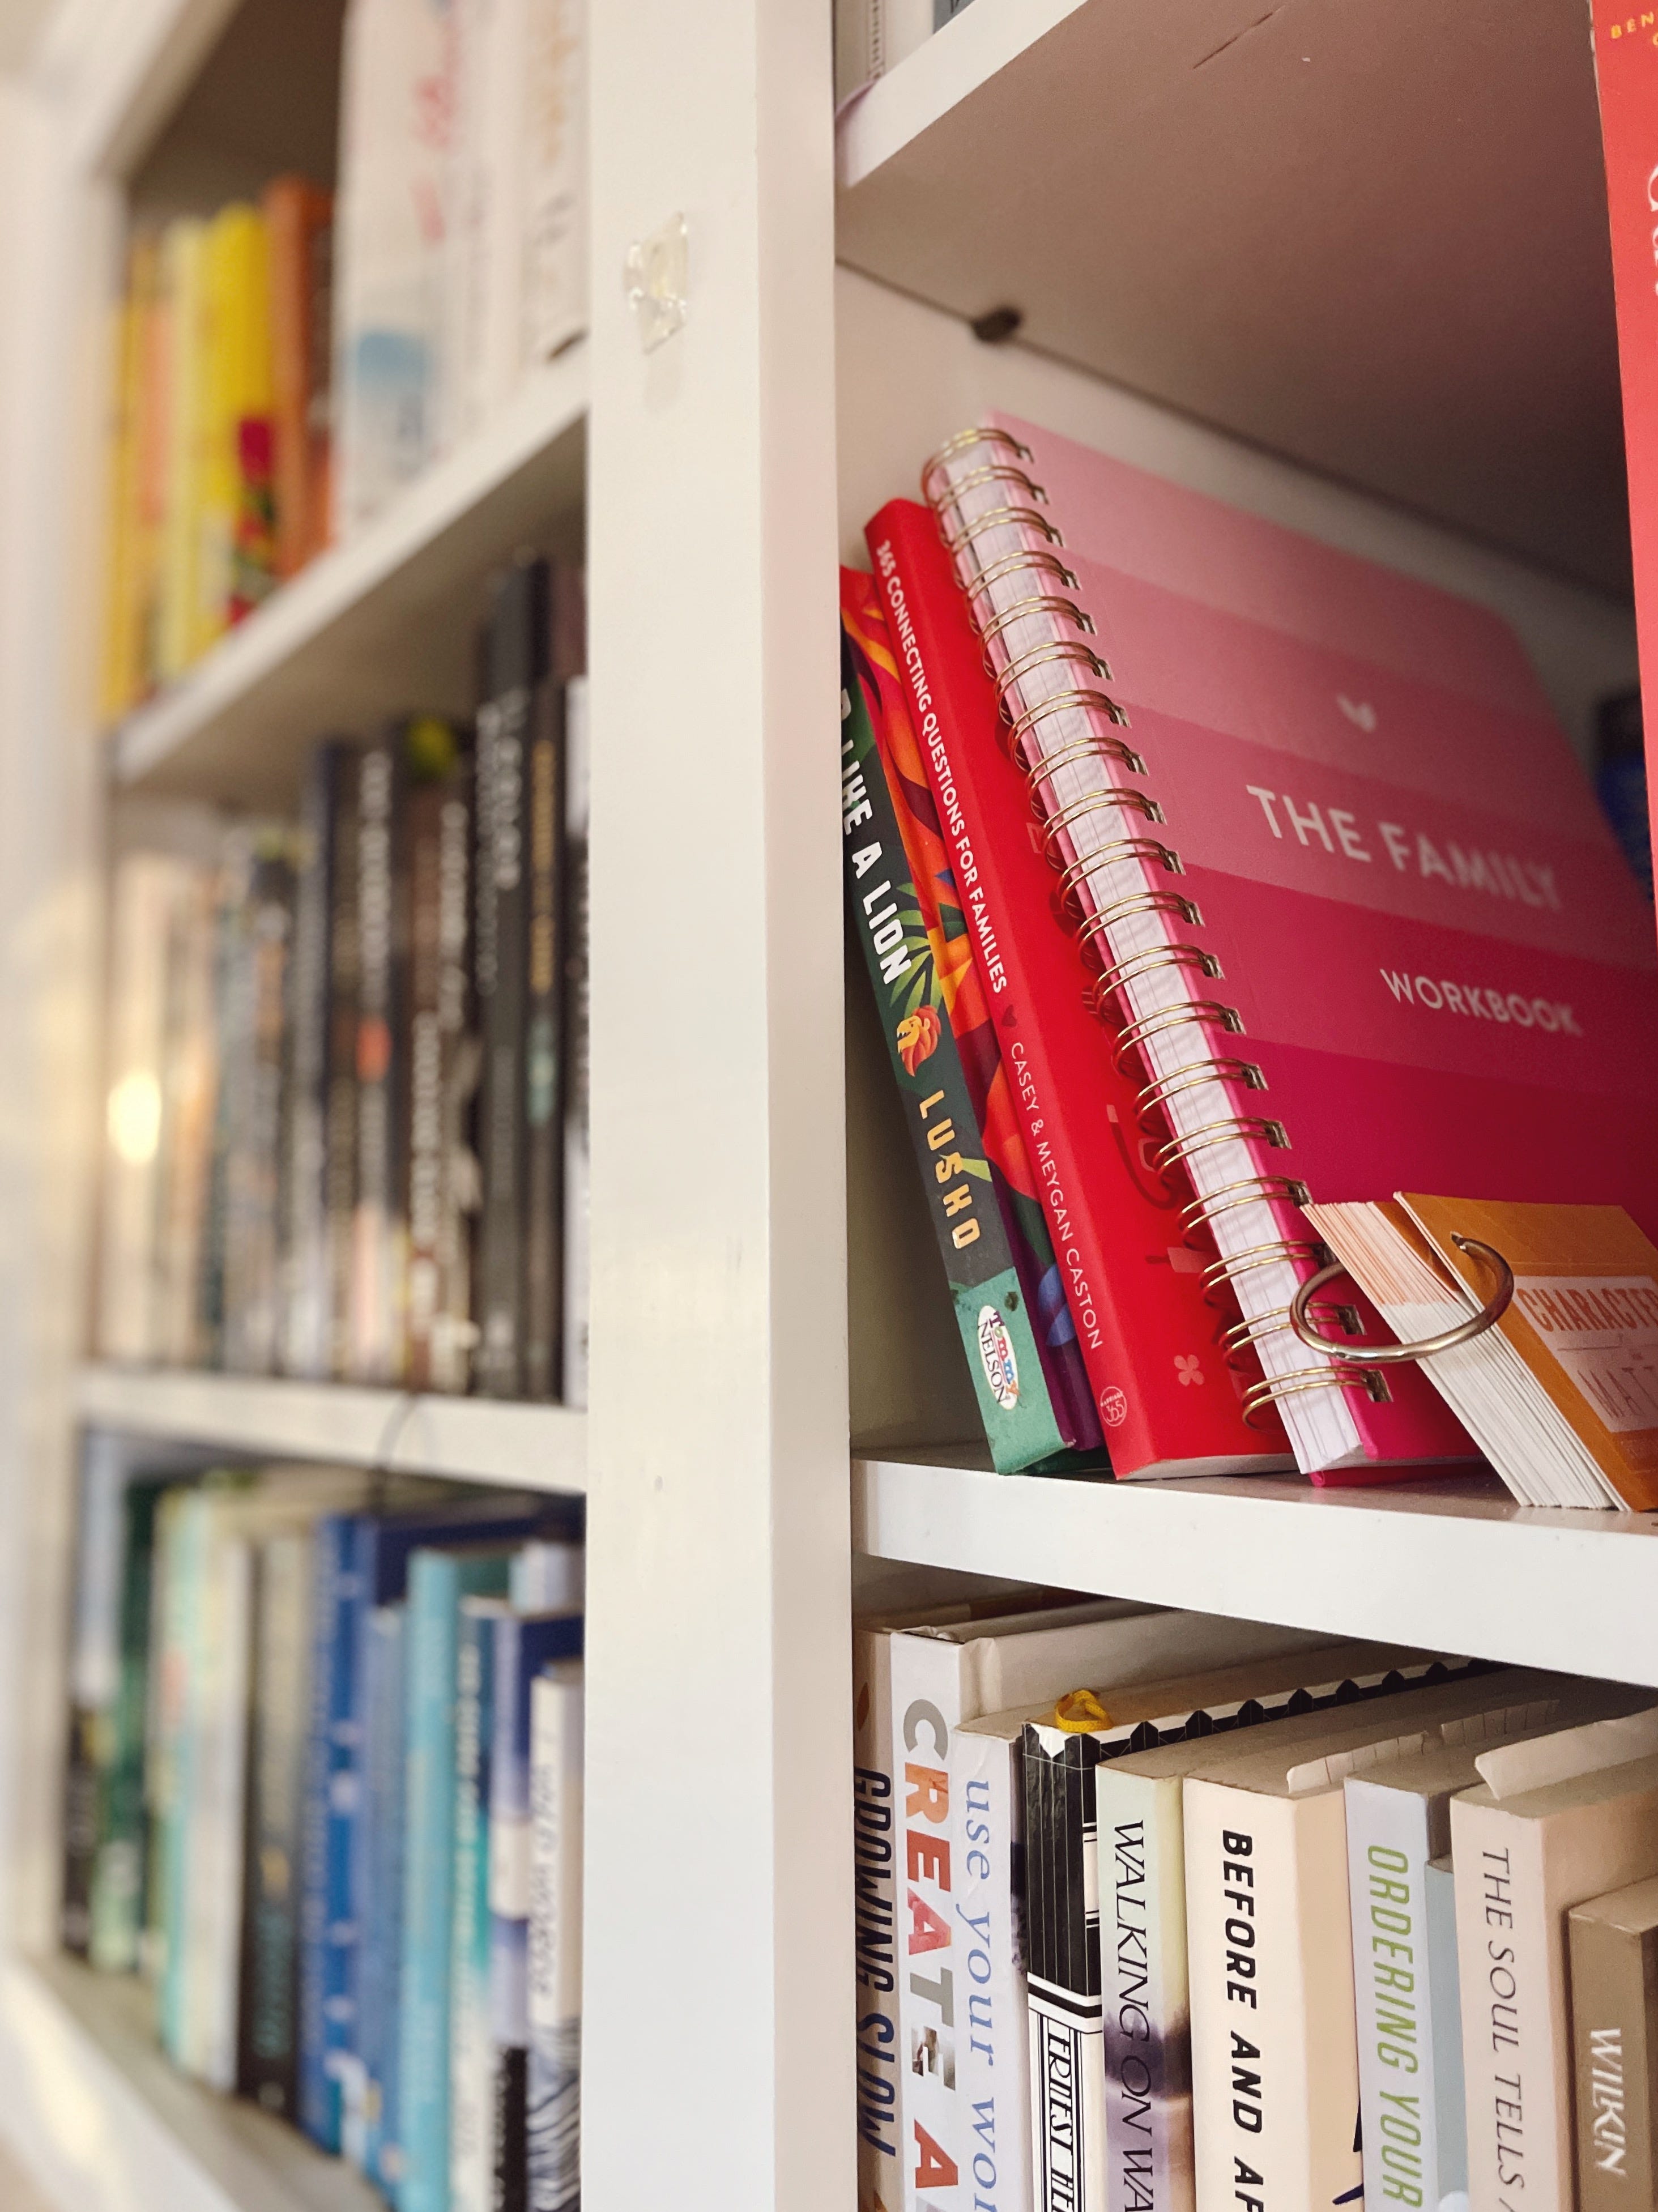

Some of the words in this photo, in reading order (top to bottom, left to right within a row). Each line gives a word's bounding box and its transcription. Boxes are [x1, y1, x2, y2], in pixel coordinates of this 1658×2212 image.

[876, 539, 896, 577] 365
[886, 576, 932, 713] CONNECTING
[922, 713, 965, 836] QUESTIONS
[956, 836, 978, 888] FOR
[970, 886, 1007, 994] FAMILIES
[852, 841, 883, 879] A
[1246, 784, 1371, 863] THE
[1378, 821, 1561, 912] FAMILY
[863, 880, 911, 984] LION
[1379, 968, 1582, 1037] WORKBOOK
[1011, 1042, 1039, 1111] CASEY
[1031, 1119, 1045, 1137] &
[919, 1089, 981, 1250] LUSKO
[1036, 1140, 1074, 1242] MEYGAN
[1067, 1248, 1103, 1349] CASTON
[978, 1322, 1008, 1403] NELSON
[966, 1780, 990, 1879] use
[903, 1699, 956, 2091] CREATE
[1114, 1819, 1150, 2041] WALKING
[1222, 1829, 1257, 2010] BEFORE
[1482, 1847, 1514, 1930] THE
[956, 1903, 994, 2066] your
[1367, 1844, 1419, 2074] ORDERING
[1487, 1940, 1519, 2053] SOUL
[1048, 2032, 1073, 2155] ERNEST
[1120, 2055, 1152, 2137] ON
[1231, 2030, 1263, 2134] AND
[1495, 2074, 1525, 2189] TELLS
[1590, 2027, 1627, 2177] WILKIN
[914, 2118, 958, 2188] A
[1051, 2167, 1074, 2212] HE
[1379, 2090, 1422, 2207] YOUR
